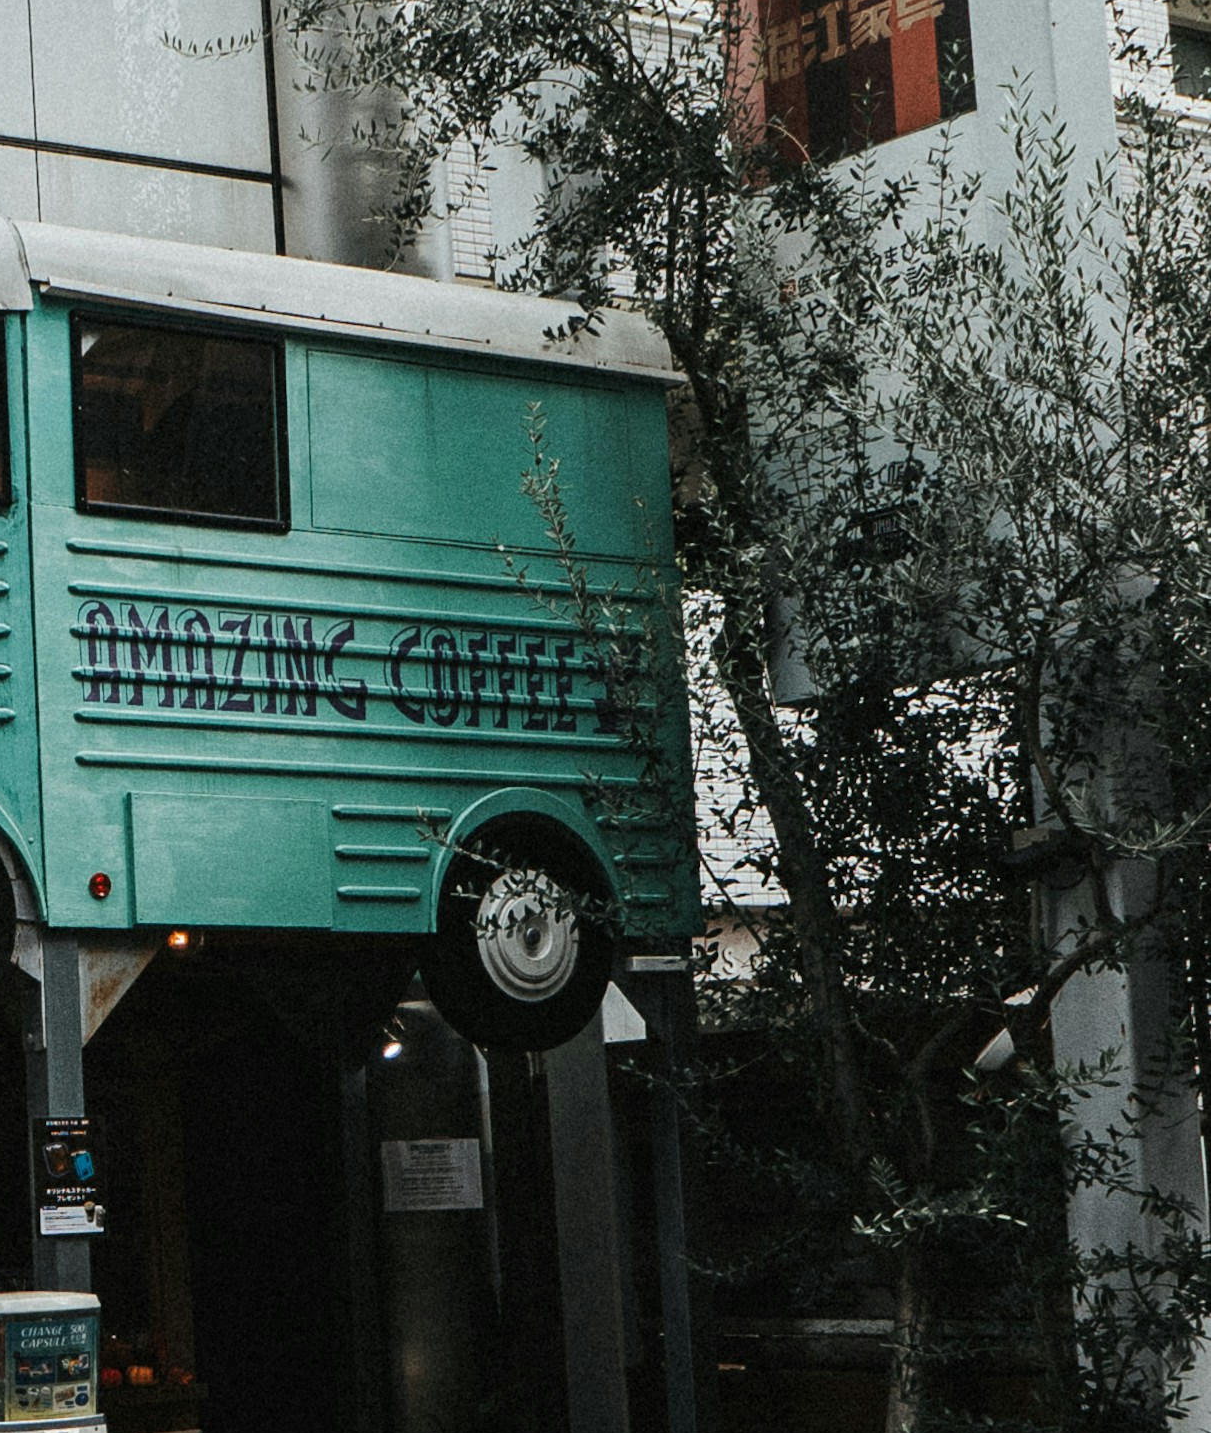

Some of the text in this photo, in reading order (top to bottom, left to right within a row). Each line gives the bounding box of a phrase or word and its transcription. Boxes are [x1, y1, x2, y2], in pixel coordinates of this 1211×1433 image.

[77, 599, 578, 733] AMAZING COFFEE
[21, 1325, 64, 1338] CHANGE
[21, 1336, 69, 1349] CAPSULE
